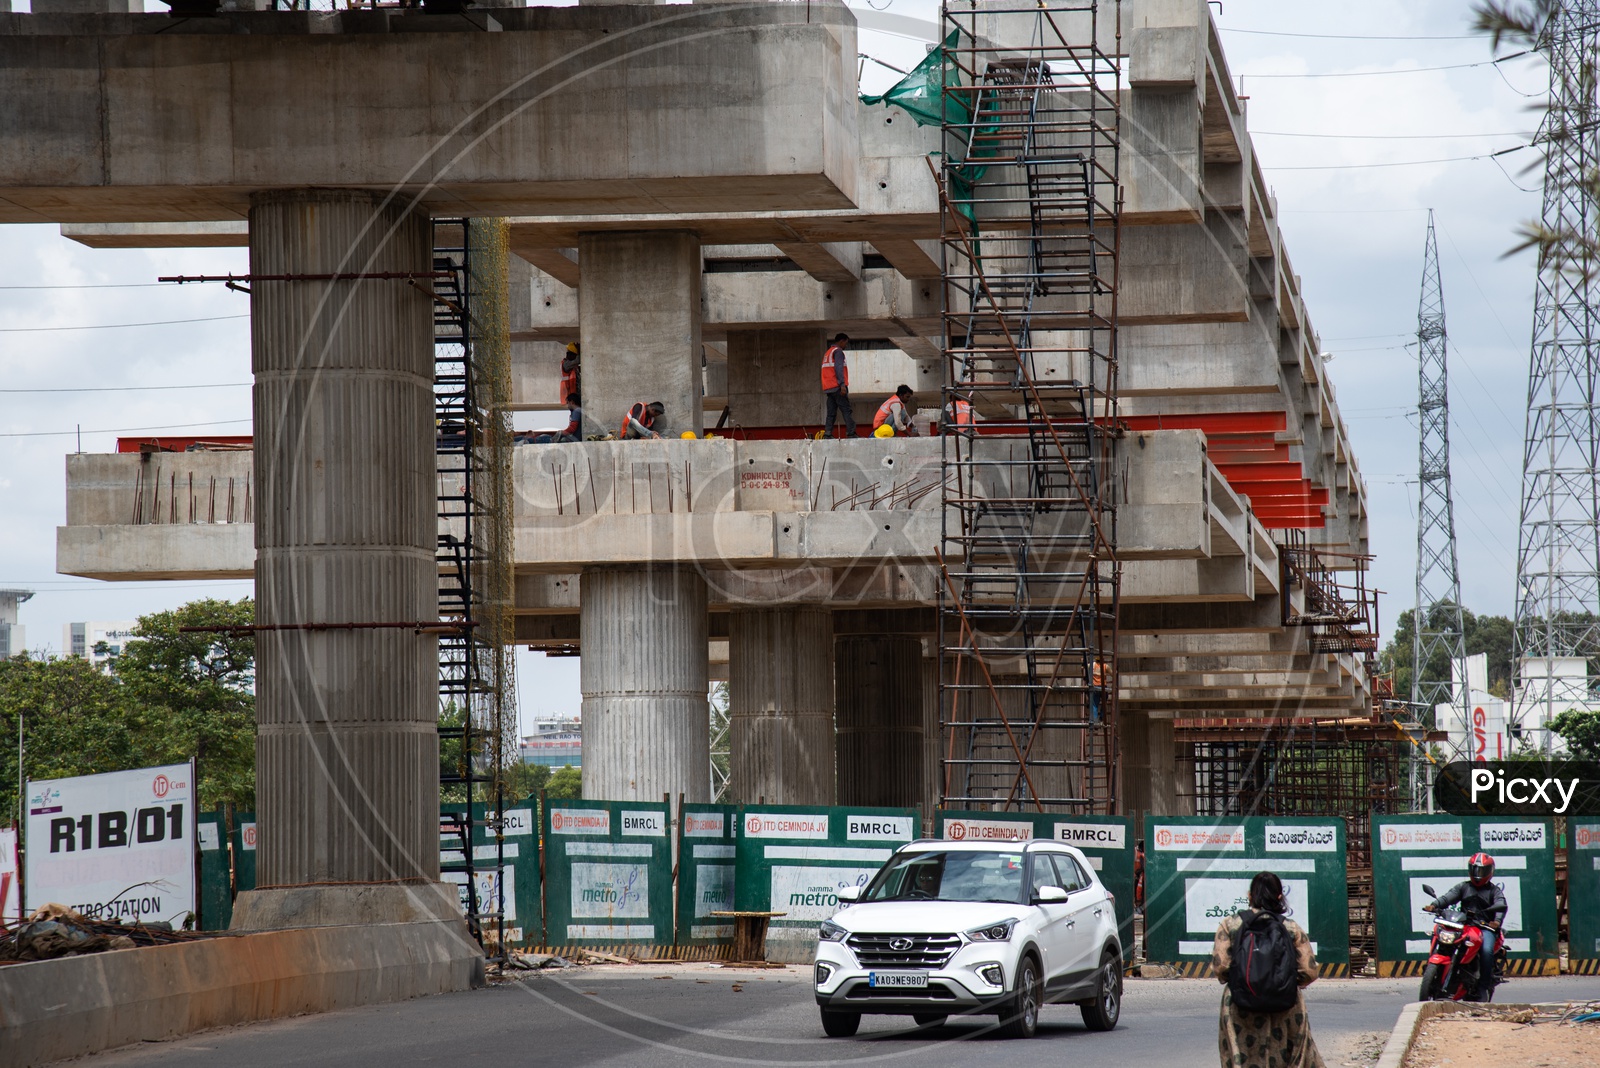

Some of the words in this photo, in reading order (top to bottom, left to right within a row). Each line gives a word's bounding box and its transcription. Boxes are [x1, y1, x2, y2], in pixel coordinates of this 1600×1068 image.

[170, 780, 186, 790] Cem
[50, 804, 183, 853] R1B/01
[563, 816, 573, 827] ITD
[574, 816, 600, 828] CEMINDIA
[601, 817, 608, 828] JV
[624, 817, 658, 829] BMRCL
[763, 820, 776, 831] ITD
[777, 821, 815, 832] CEMINDIA
[816, 822, 826, 833] JV
[850, 822, 901, 834] BMRCL
[968, 826, 981, 837] ITD
[982, 827, 1018, 840] CEMINDIA
[1019, 829, 1030, 840] JV
[1061, 828, 1117, 842] BMRCL
[582, 889, 617, 903] metro
[703, 890, 727, 903] metro
[789, 893, 838, 907] metro
[107, 897, 160, 918] STATION
